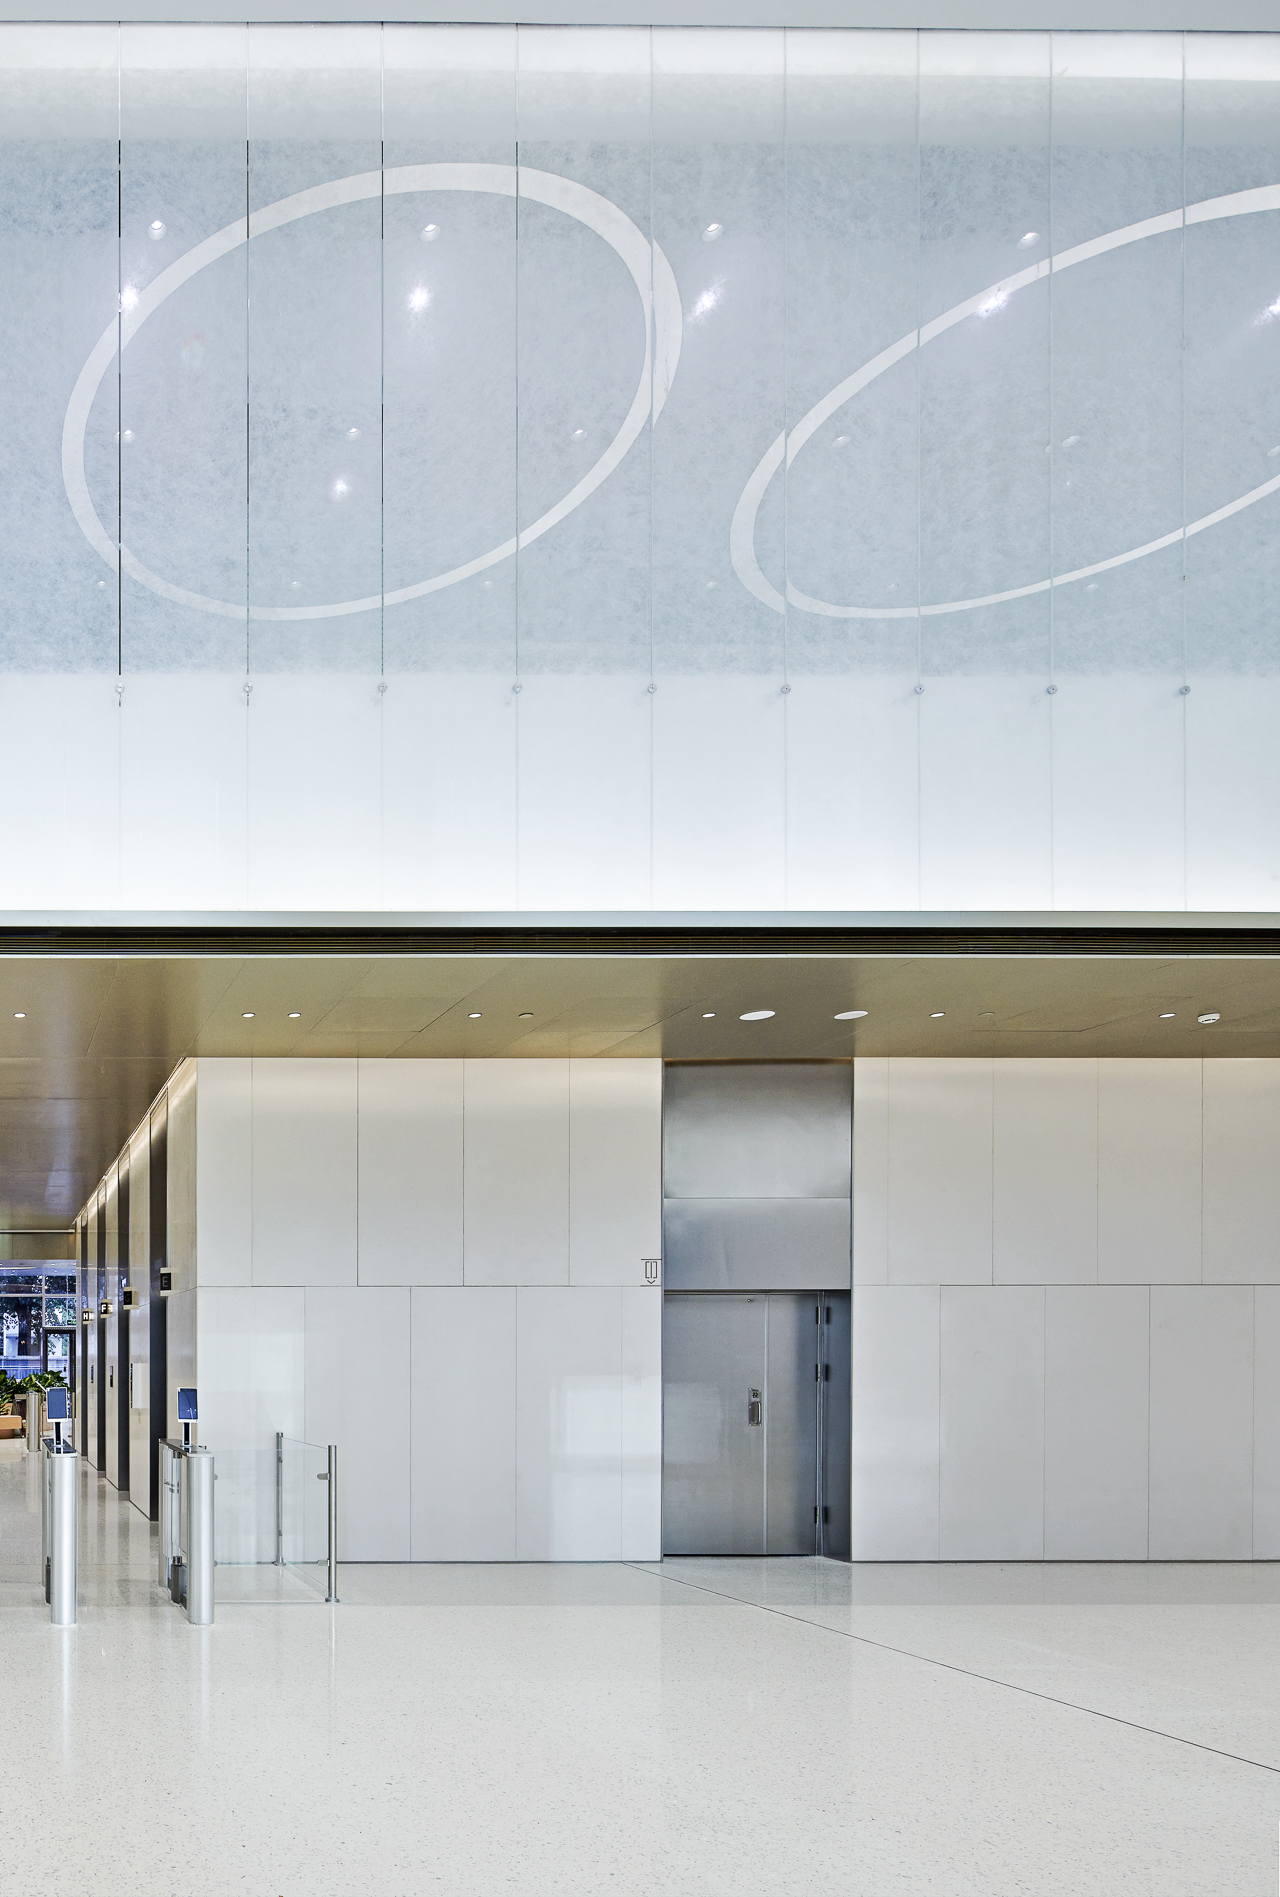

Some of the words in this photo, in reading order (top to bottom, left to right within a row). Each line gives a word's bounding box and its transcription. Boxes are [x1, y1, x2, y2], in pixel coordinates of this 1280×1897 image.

[162, 1276, 169, 1288] E
[101, 1303, 107, 1313] F
[83, 1312, 89, 1320] H
